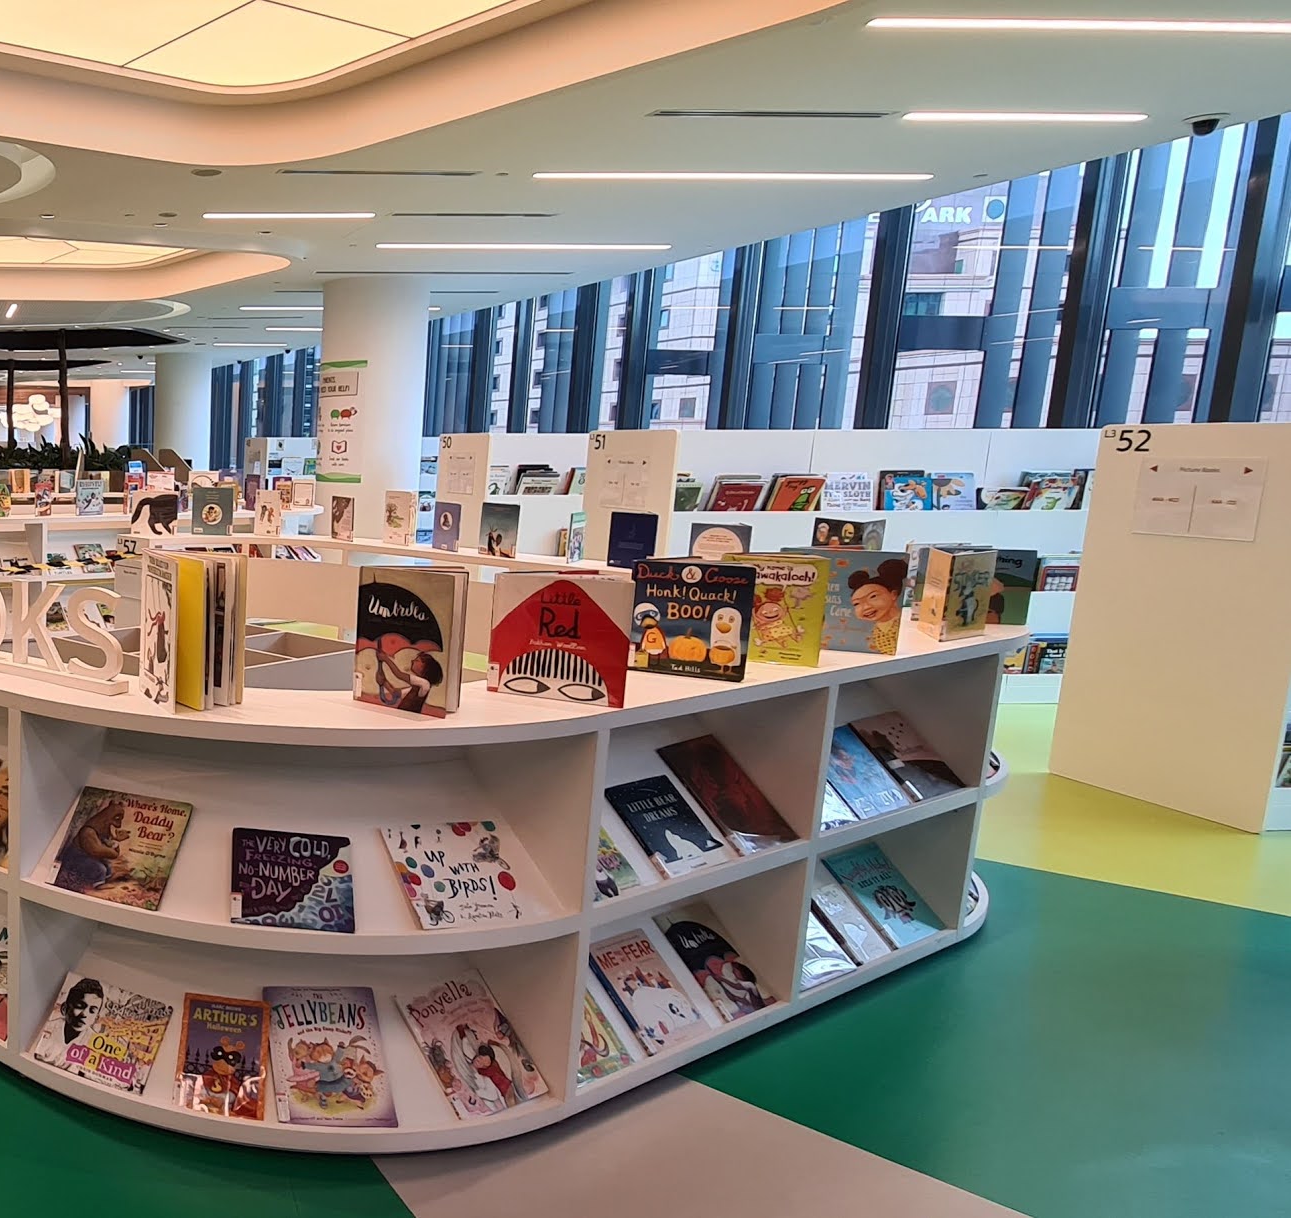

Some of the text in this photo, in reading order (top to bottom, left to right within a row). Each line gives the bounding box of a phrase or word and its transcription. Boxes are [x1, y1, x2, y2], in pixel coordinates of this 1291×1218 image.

[442, 436, 452, 449] 50
[594, 434, 606, 450] 51
[1104, 430, 1152, 452] L3 52
[824, 481, 871, 491] MERVIN
[124, 539, 136, 554] 57
[637, 563, 749, 585] Duck & Goose
[757, 571, 815, 582] awakaloch!
[541, 591, 581, 606] Little
[646, 583, 737, 603] Honk! Quack!
[369, 594, 429, 620] Umbrella
[667, 602, 711, 622] BOO!
[539, 607, 581, 639] Red
[125, 798, 158, 812] Where's
[627, 793, 678, 813] LITTLE BEAR
[133, 811, 174, 831] Daddy
[643, 806, 678, 823] DREAMS
[242, 839, 255, 848] THE
[255, 835, 286, 853] VERY
[424, 850, 445, 867] UP
[449, 862, 480, 875] WITH
[238, 862, 315, 887] NO-NUMBER
[251, 877, 292, 902] DAY
[442, 875, 497, 900] BIRDS!
[596, 940, 655, 970] ME FEAR
[406, 980, 472, 1028] Ponyella
[193, 1007, 258, 1027] ARTHUR'S
[272, 999, 367, 1030] JELLYBEANS
[206, 1022, 242, 1033] Halloween
[93, 1036, 122, 1055] One
[70, 1047, 133, 1080] of a Kind
